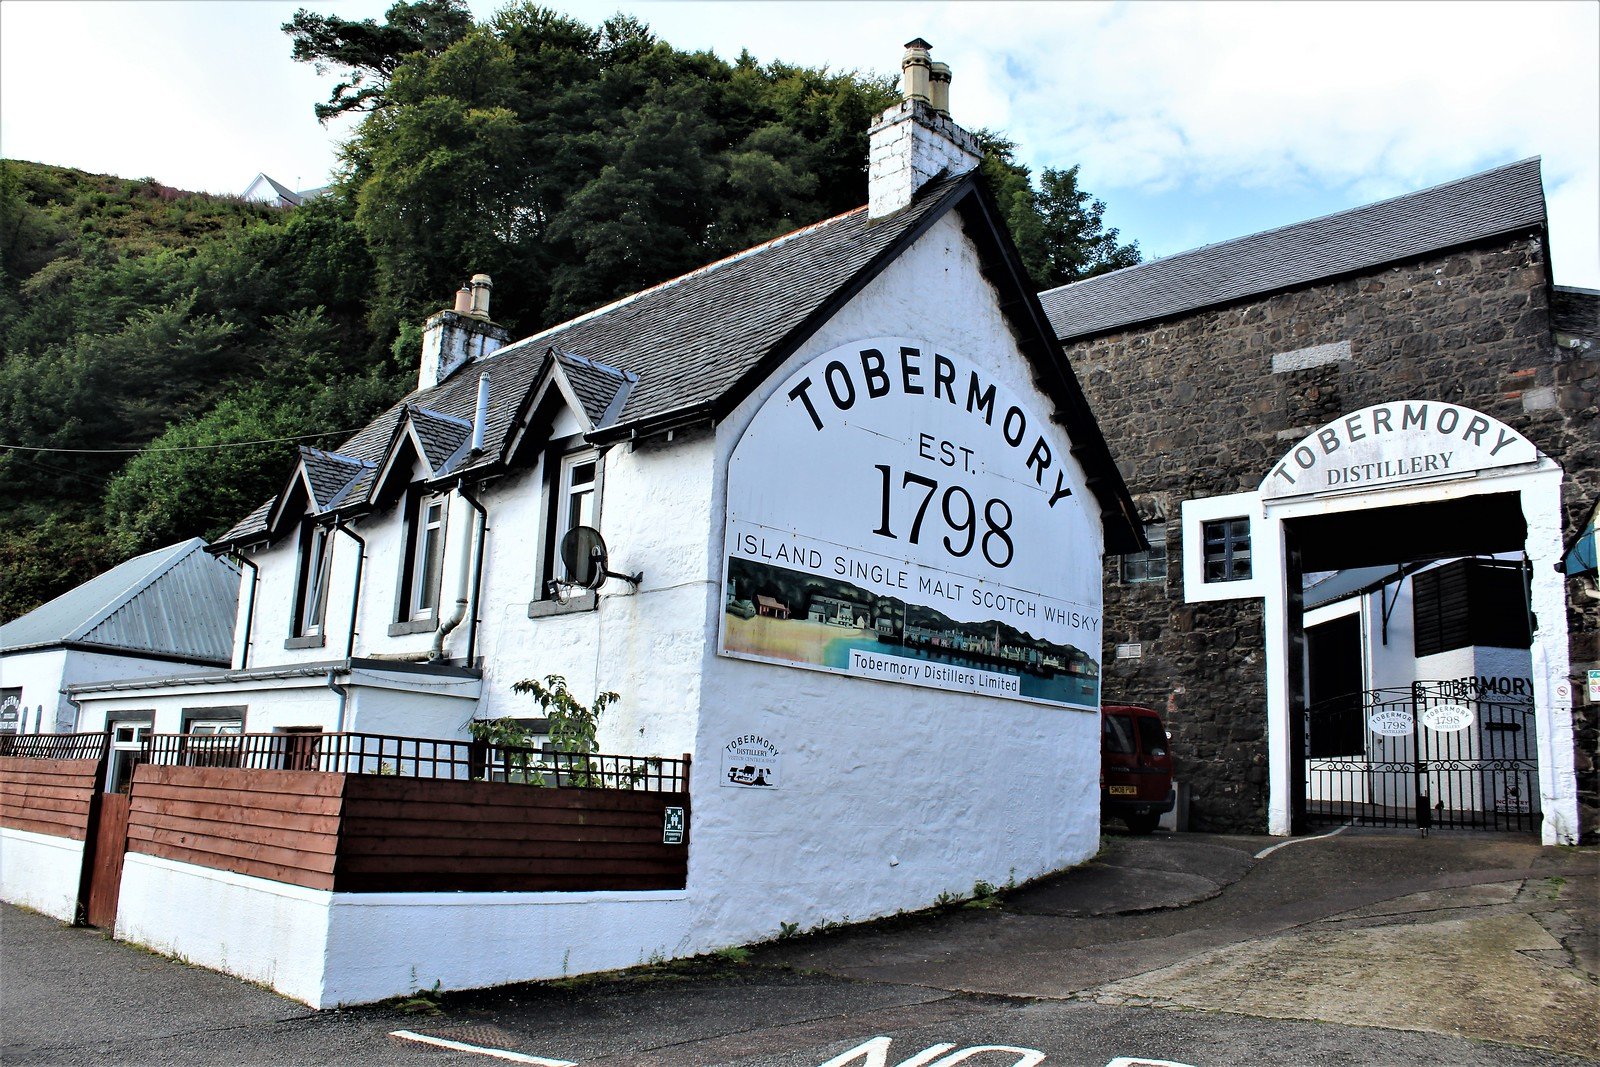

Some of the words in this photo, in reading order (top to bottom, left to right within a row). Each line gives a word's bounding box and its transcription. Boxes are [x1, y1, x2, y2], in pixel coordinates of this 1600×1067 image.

[788, 346, 1073, 508] TOBERMORY
[1273, 404, 1518, 485] TOBERMORY
[919, 433, 976, 475] EST.
[1326, 451, 1454, 486] DISTILLERY
[872, 464, 1014, 569] 1798
[737, 533, 822, 569] ISLAND
[834, 557, 908, 589] SINGLE
[918, 576, 964, 601] MALT
[972, 589, 1036, 618] SCOTCH
[1044, 606, 1099, 632] WHISKY
[854, 654, 920, 680] Tobermory
[924, 665, 975, 685] Distillers
[978, 674, 1017, 692] Limited
[1383, 721, 1407, 730] 1798
[1426, 706, 1470, 719] TOBERMORY
[1435, 716, 1460, 724] 1798
[726, 734, 779, 757] TOBERMORY
[736, 748, 768, 757] DISTILLERY
